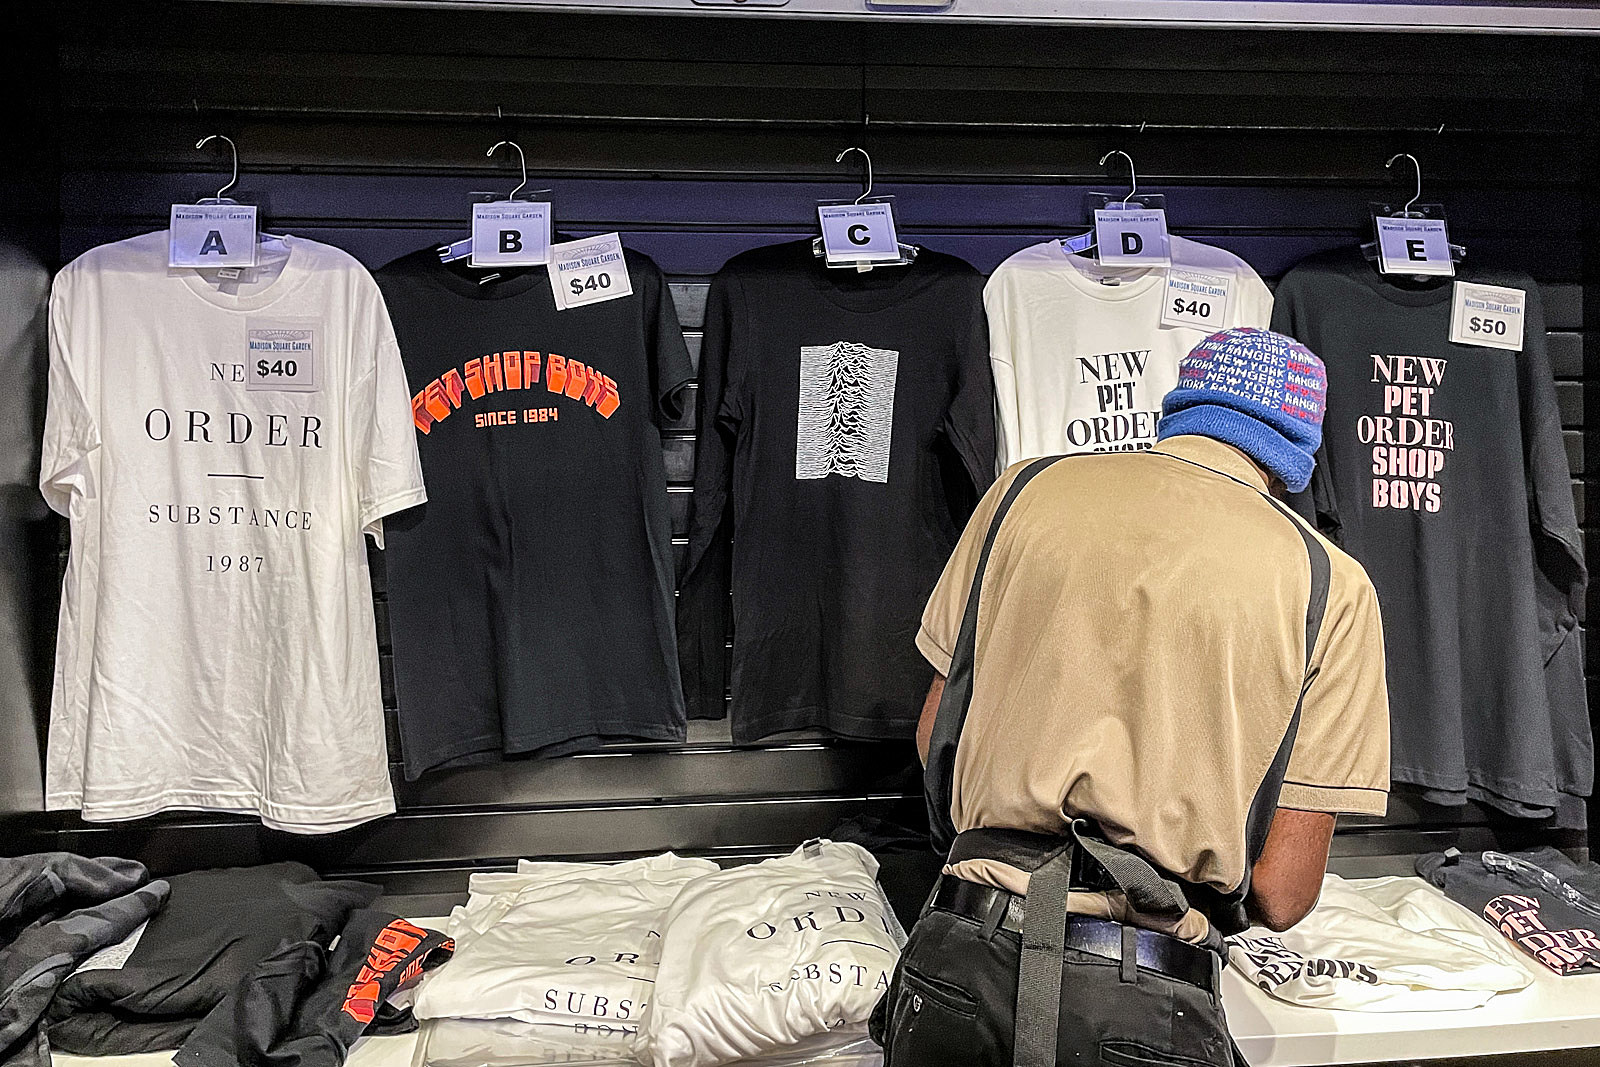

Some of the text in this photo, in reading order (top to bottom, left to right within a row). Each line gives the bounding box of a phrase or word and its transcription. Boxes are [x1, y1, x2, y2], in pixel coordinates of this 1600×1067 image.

[199, 230, 228, 255] A
[499, 230, 523, 254] B
[848, 224, 871, 246] C
[1121, 232, 1143, 255] D
[1406, 239, 1428, 261] E
[558, 254, 621, 272] MADISON SQUARE GARDEN
[570, 272, 611, 296] $40
[1169, 280, 1190, 290] MADISON
[1190, 282, 1208, 294] SQUARE
[1208, 286, 1226, 297] GARDEN
[1173, 297, 1211, 318] $40
[1469, 316, 1507, 336] $50
[249, 341, 272, 350] MADISON
[1226, 344, 1287, 368] RANGERS
[1255, 341, 1288, 358] YORK
[210, 363, 245, 382] NE
[257, 359, 298, 379] $40
[1075, 349, 1152, 384] NEW
[1214, 352, 1248, 367] NEW
[1250, 361, 1285, 379] YORK
[1218, 364, 1284, 389] RANGERS
[1370, 354, 1448, 386] NEW
[411, 350, 621, 435] PET SHOP BOYS
[1096, 382, 1136, 412] PET
[1206, 371, 1242, 386] NEW
[1244, 379, 1283, 401] YORK
[1384, 385, 1434, 416] PET
[145, 408, 323, 448] ORDER
[475, 407, 559, 428] SINCE 1984
[1356, 415, 1454, 451] ORDER
[1372, 446, 1444, 479] SHOP
[1372, 478, 1441, 513] BOYS
[148, 503, 313, 531] SUBSTANCE
[206, 555, 264, 573] 1987
[805, 891, 867, 901] NEW
[1484, 894, 1541, 928] EW
[544, 988, 648, 1020] SUBS
